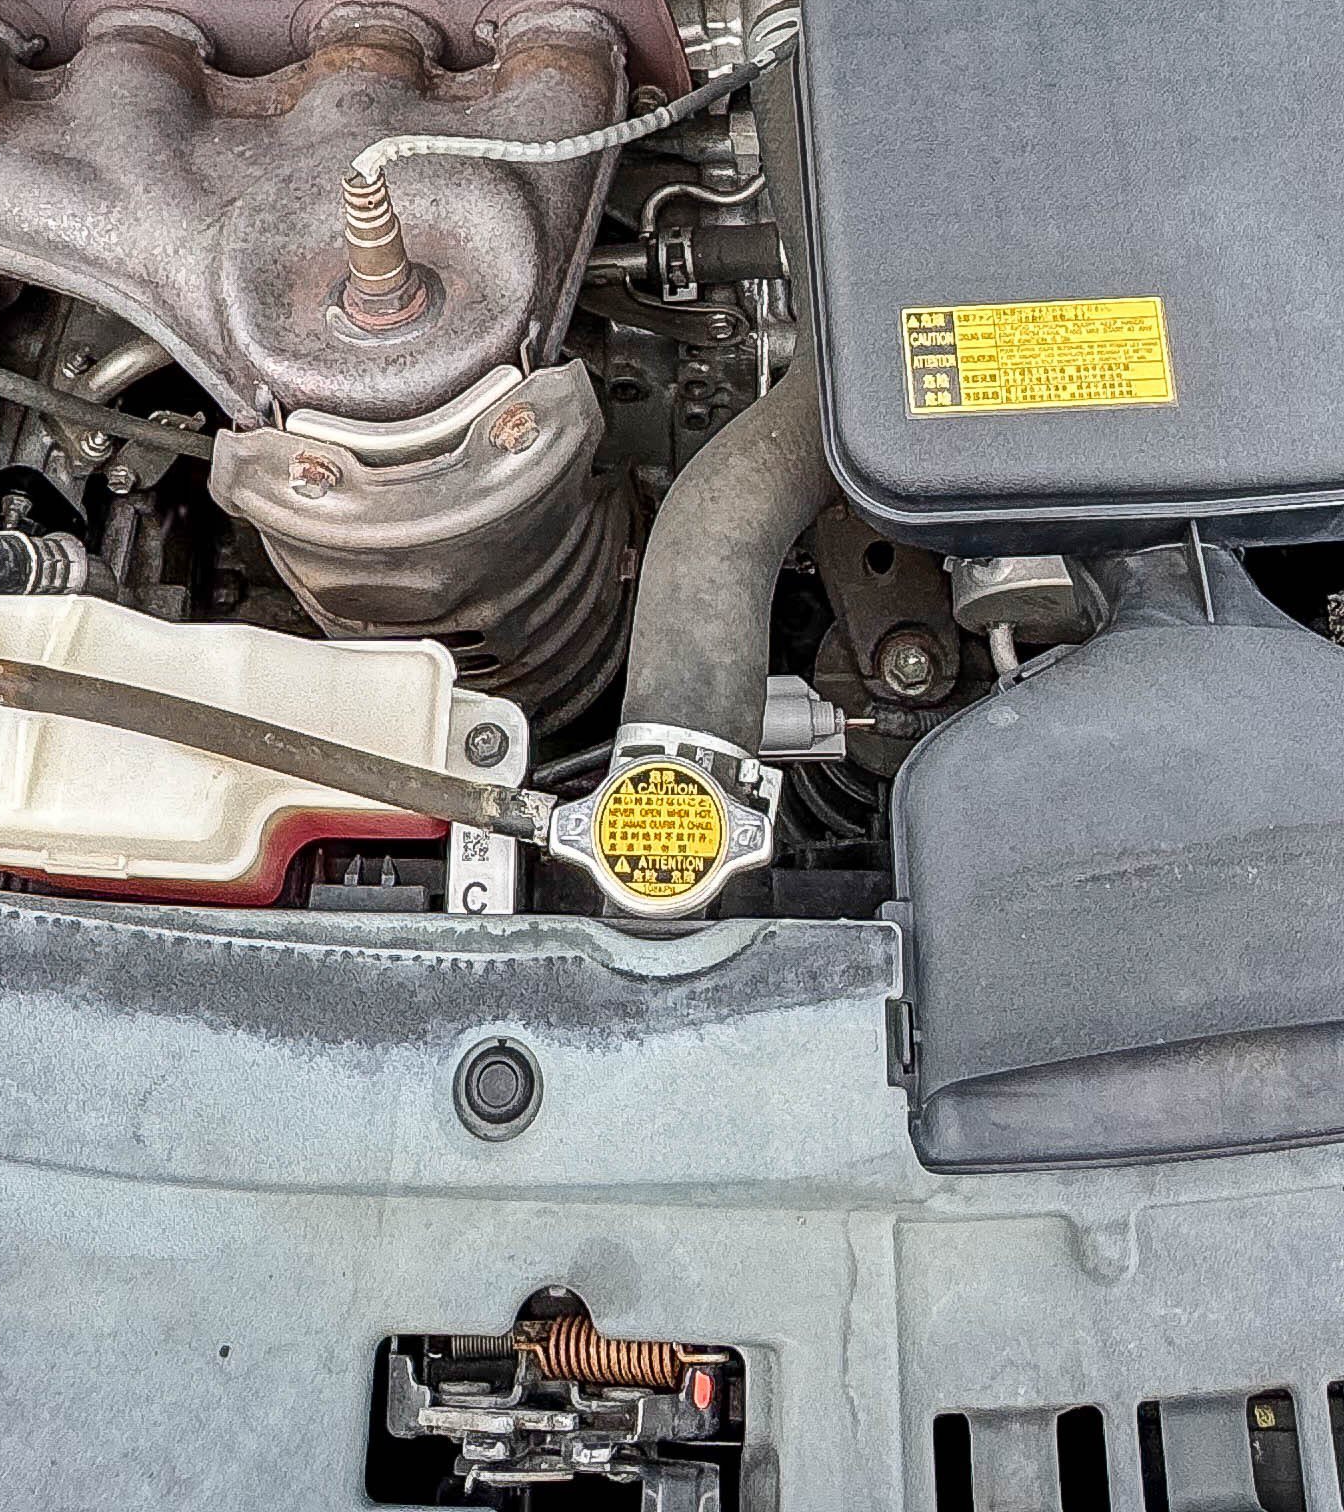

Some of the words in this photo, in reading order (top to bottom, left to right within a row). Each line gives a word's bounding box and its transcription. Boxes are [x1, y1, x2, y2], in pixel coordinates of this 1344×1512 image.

[910, 332, 955, 348] CAUTION
[637, 782, 698, 795] CAUTION
[640, 808, 662, 818] OPEN
[667, 808, 690, 818] WHEN
[638, 855, 704, 872] ATTENTION
